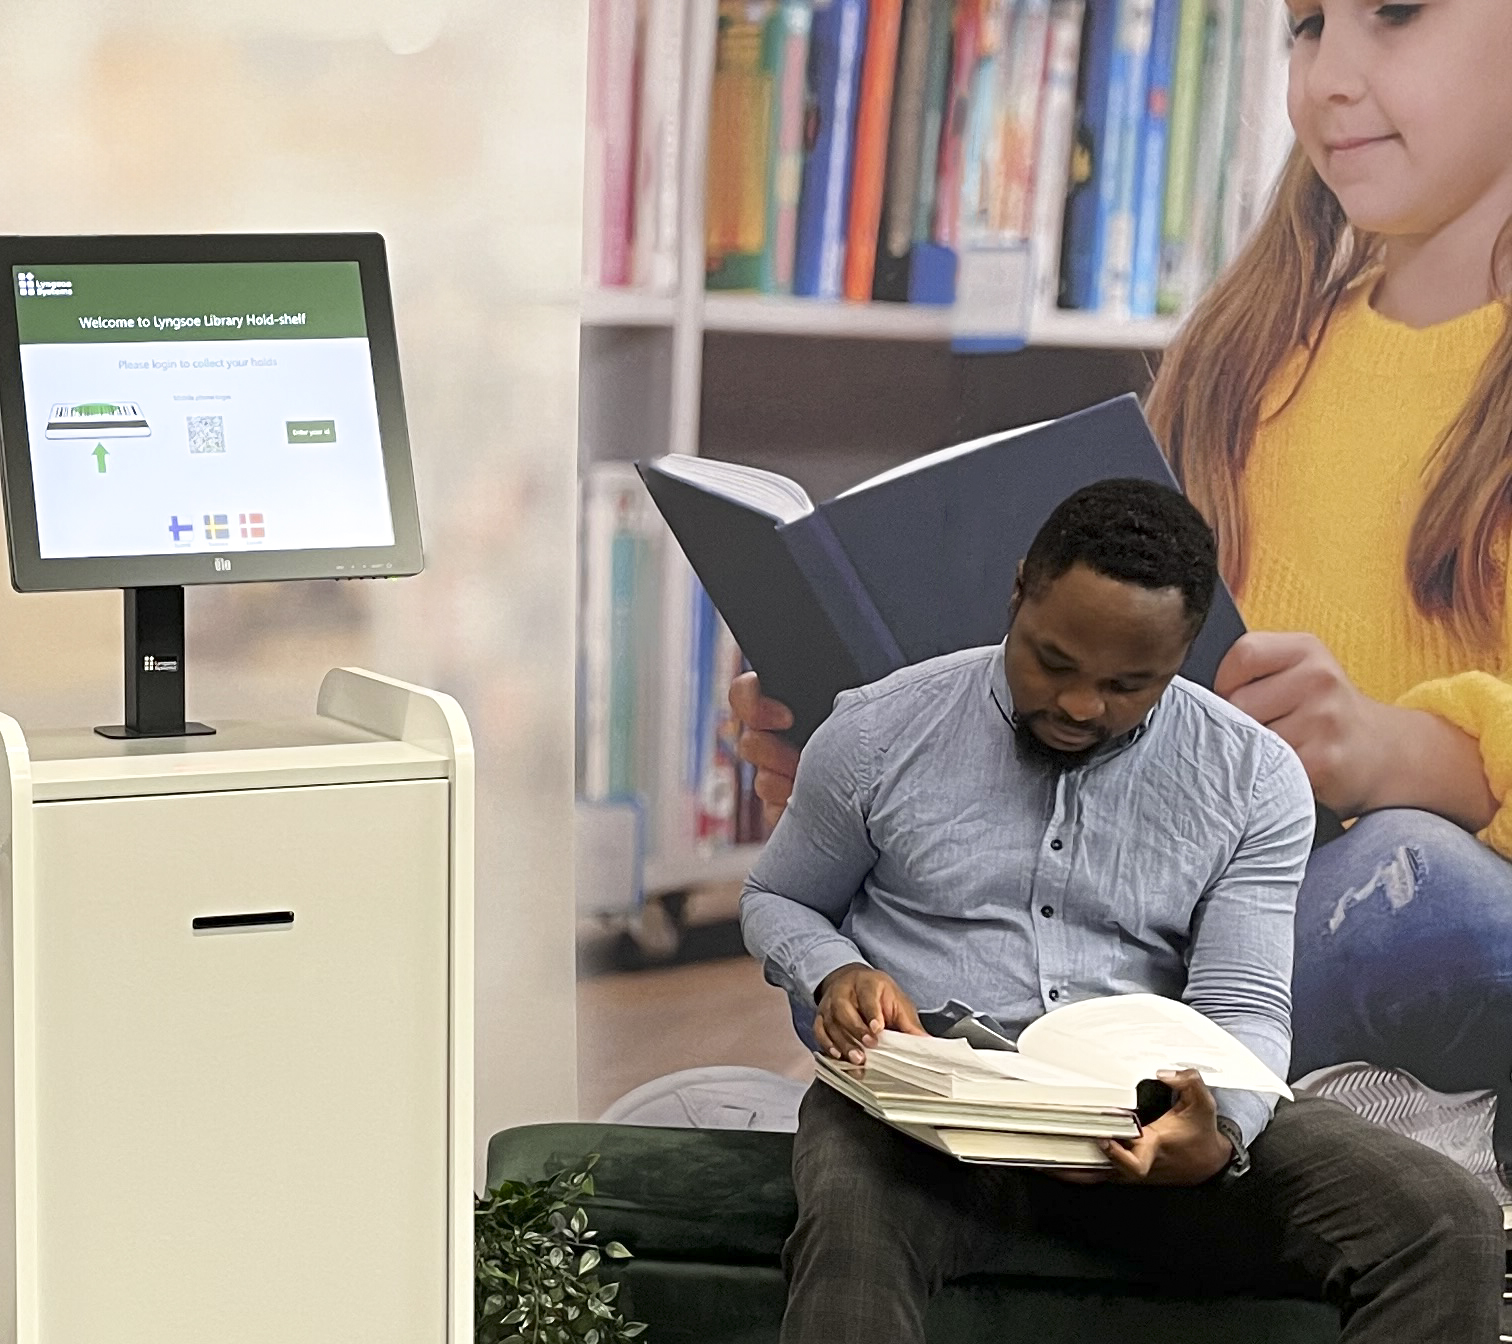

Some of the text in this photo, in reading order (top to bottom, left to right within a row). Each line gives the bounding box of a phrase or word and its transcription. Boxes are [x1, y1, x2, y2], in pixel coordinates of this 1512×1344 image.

[78, 313, 306, 331] Welcome to Lyngsoe Library Hold-shelf
[118, 357, 278, 371] Please login to collect your holds
